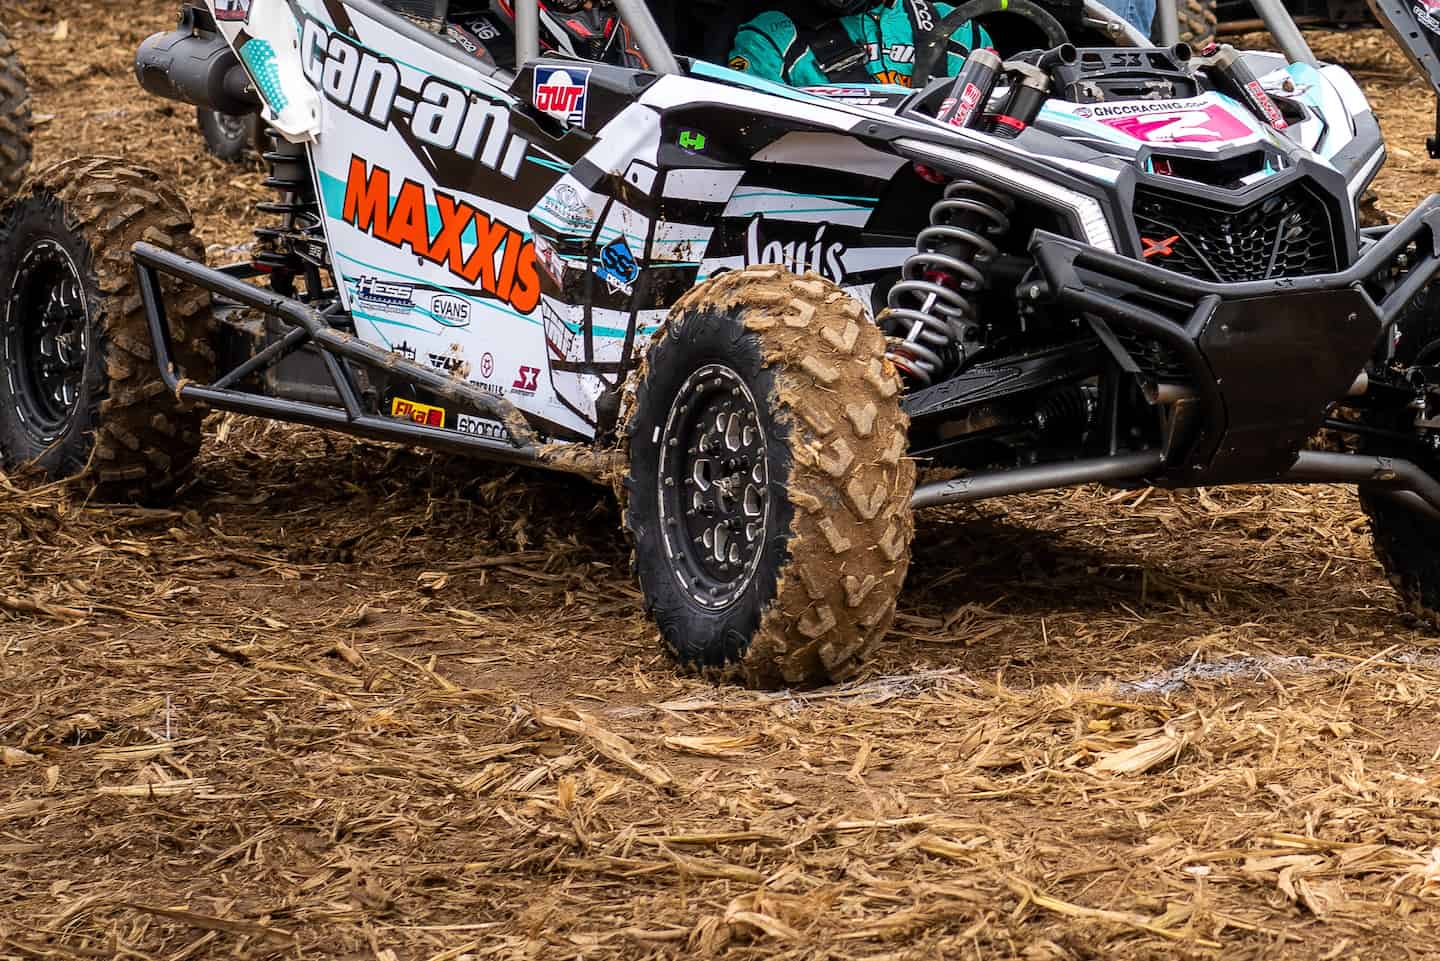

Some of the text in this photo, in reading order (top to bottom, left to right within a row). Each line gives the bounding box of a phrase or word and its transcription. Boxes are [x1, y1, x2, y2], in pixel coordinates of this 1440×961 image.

[300, 17, 530, 181] can-am
[342, 152, 542, 315] MAXXIS
[433, 299, 469, 319] EVANS
